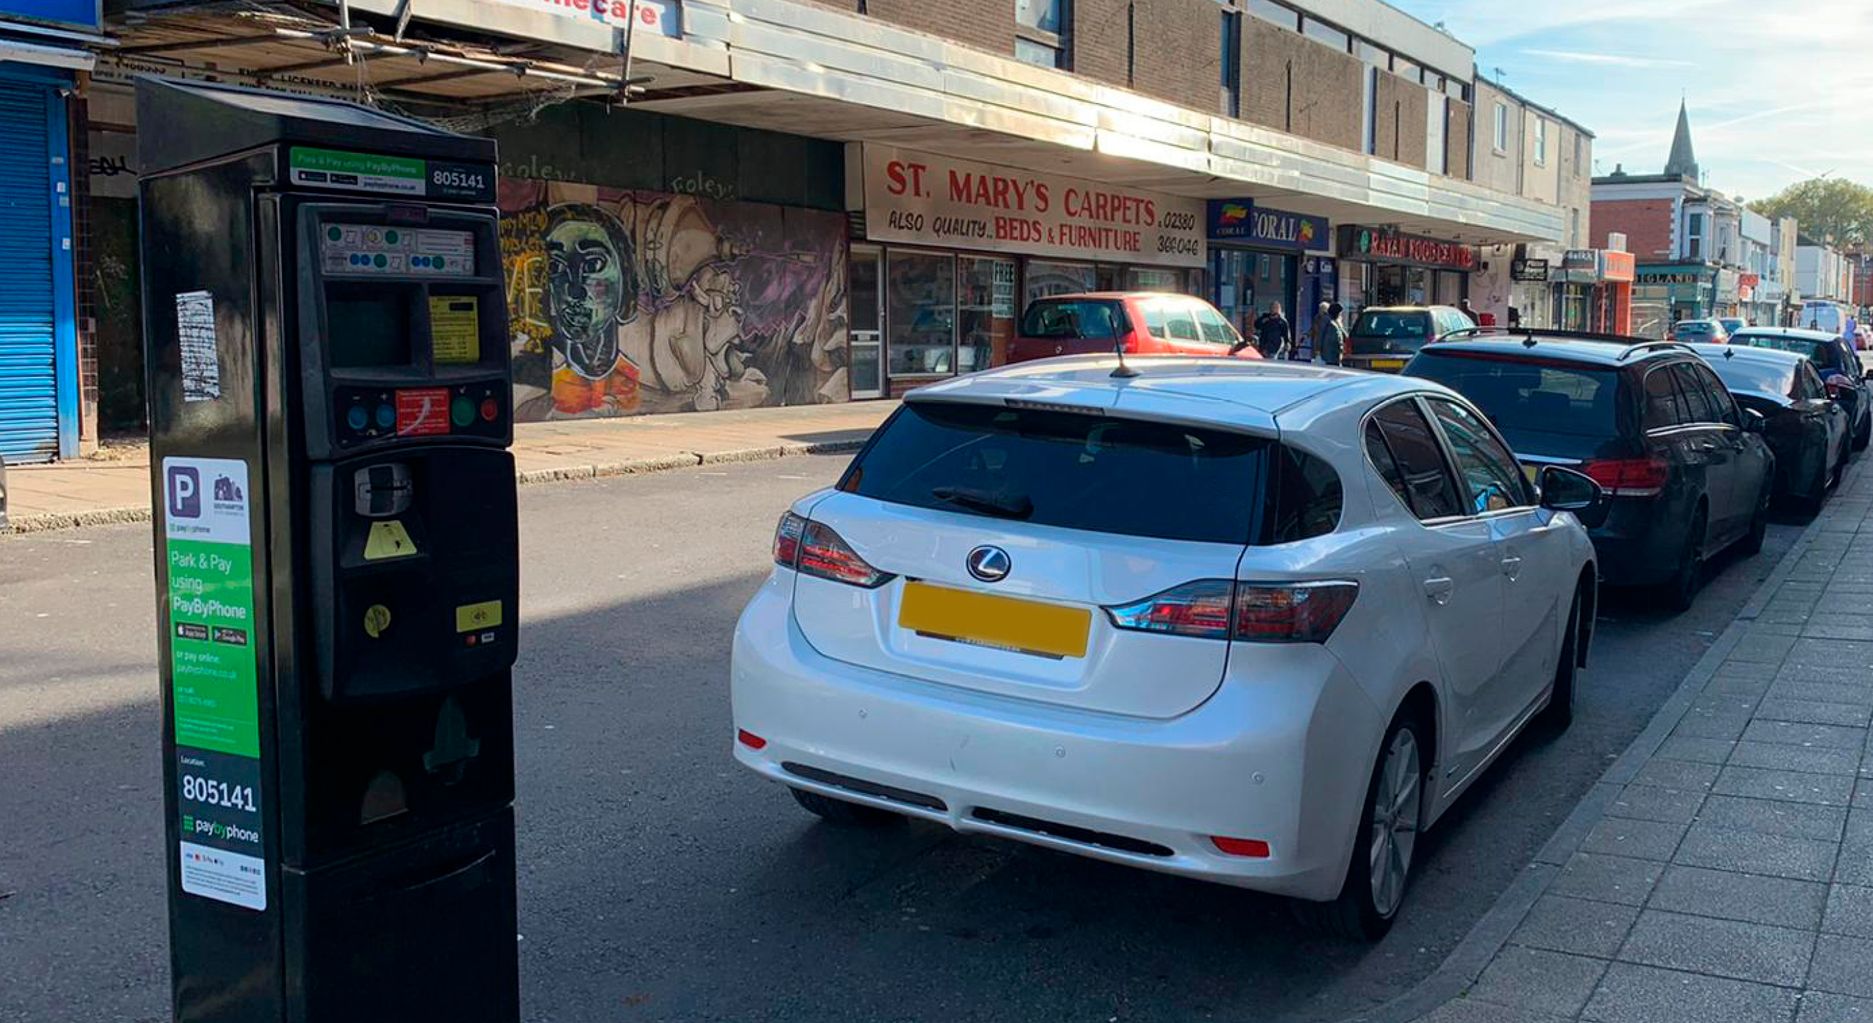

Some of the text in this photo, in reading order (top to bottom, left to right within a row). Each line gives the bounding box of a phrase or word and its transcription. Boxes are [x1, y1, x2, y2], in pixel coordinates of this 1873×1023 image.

[433, 170, 486, 189] 805141
[886, 160, 931, 197] ST.
[948, 169, 1050, 212] MARY'S
[1063, 188, 1156, 227] CARPETS
[887, 209, 924, 232] ALSO
[994, 216, 1043, 243] BEDS
[1047, 229, 1055, 244] &
[1058, 222, 1141, 252] FURNITURE
[1371, 230, 1407, 259] RAYAN
[994, 262, 1014, 283] FREE
[174, 474, 194, 510] P
[171, 550, 232, 575] Park & Pay
[172, 575, 203, 594] using
[173, 598, 247, 620] PayByPhone
[183, 775, 257, 813] 805141
[195, 818, 260, 843] paybyphone
